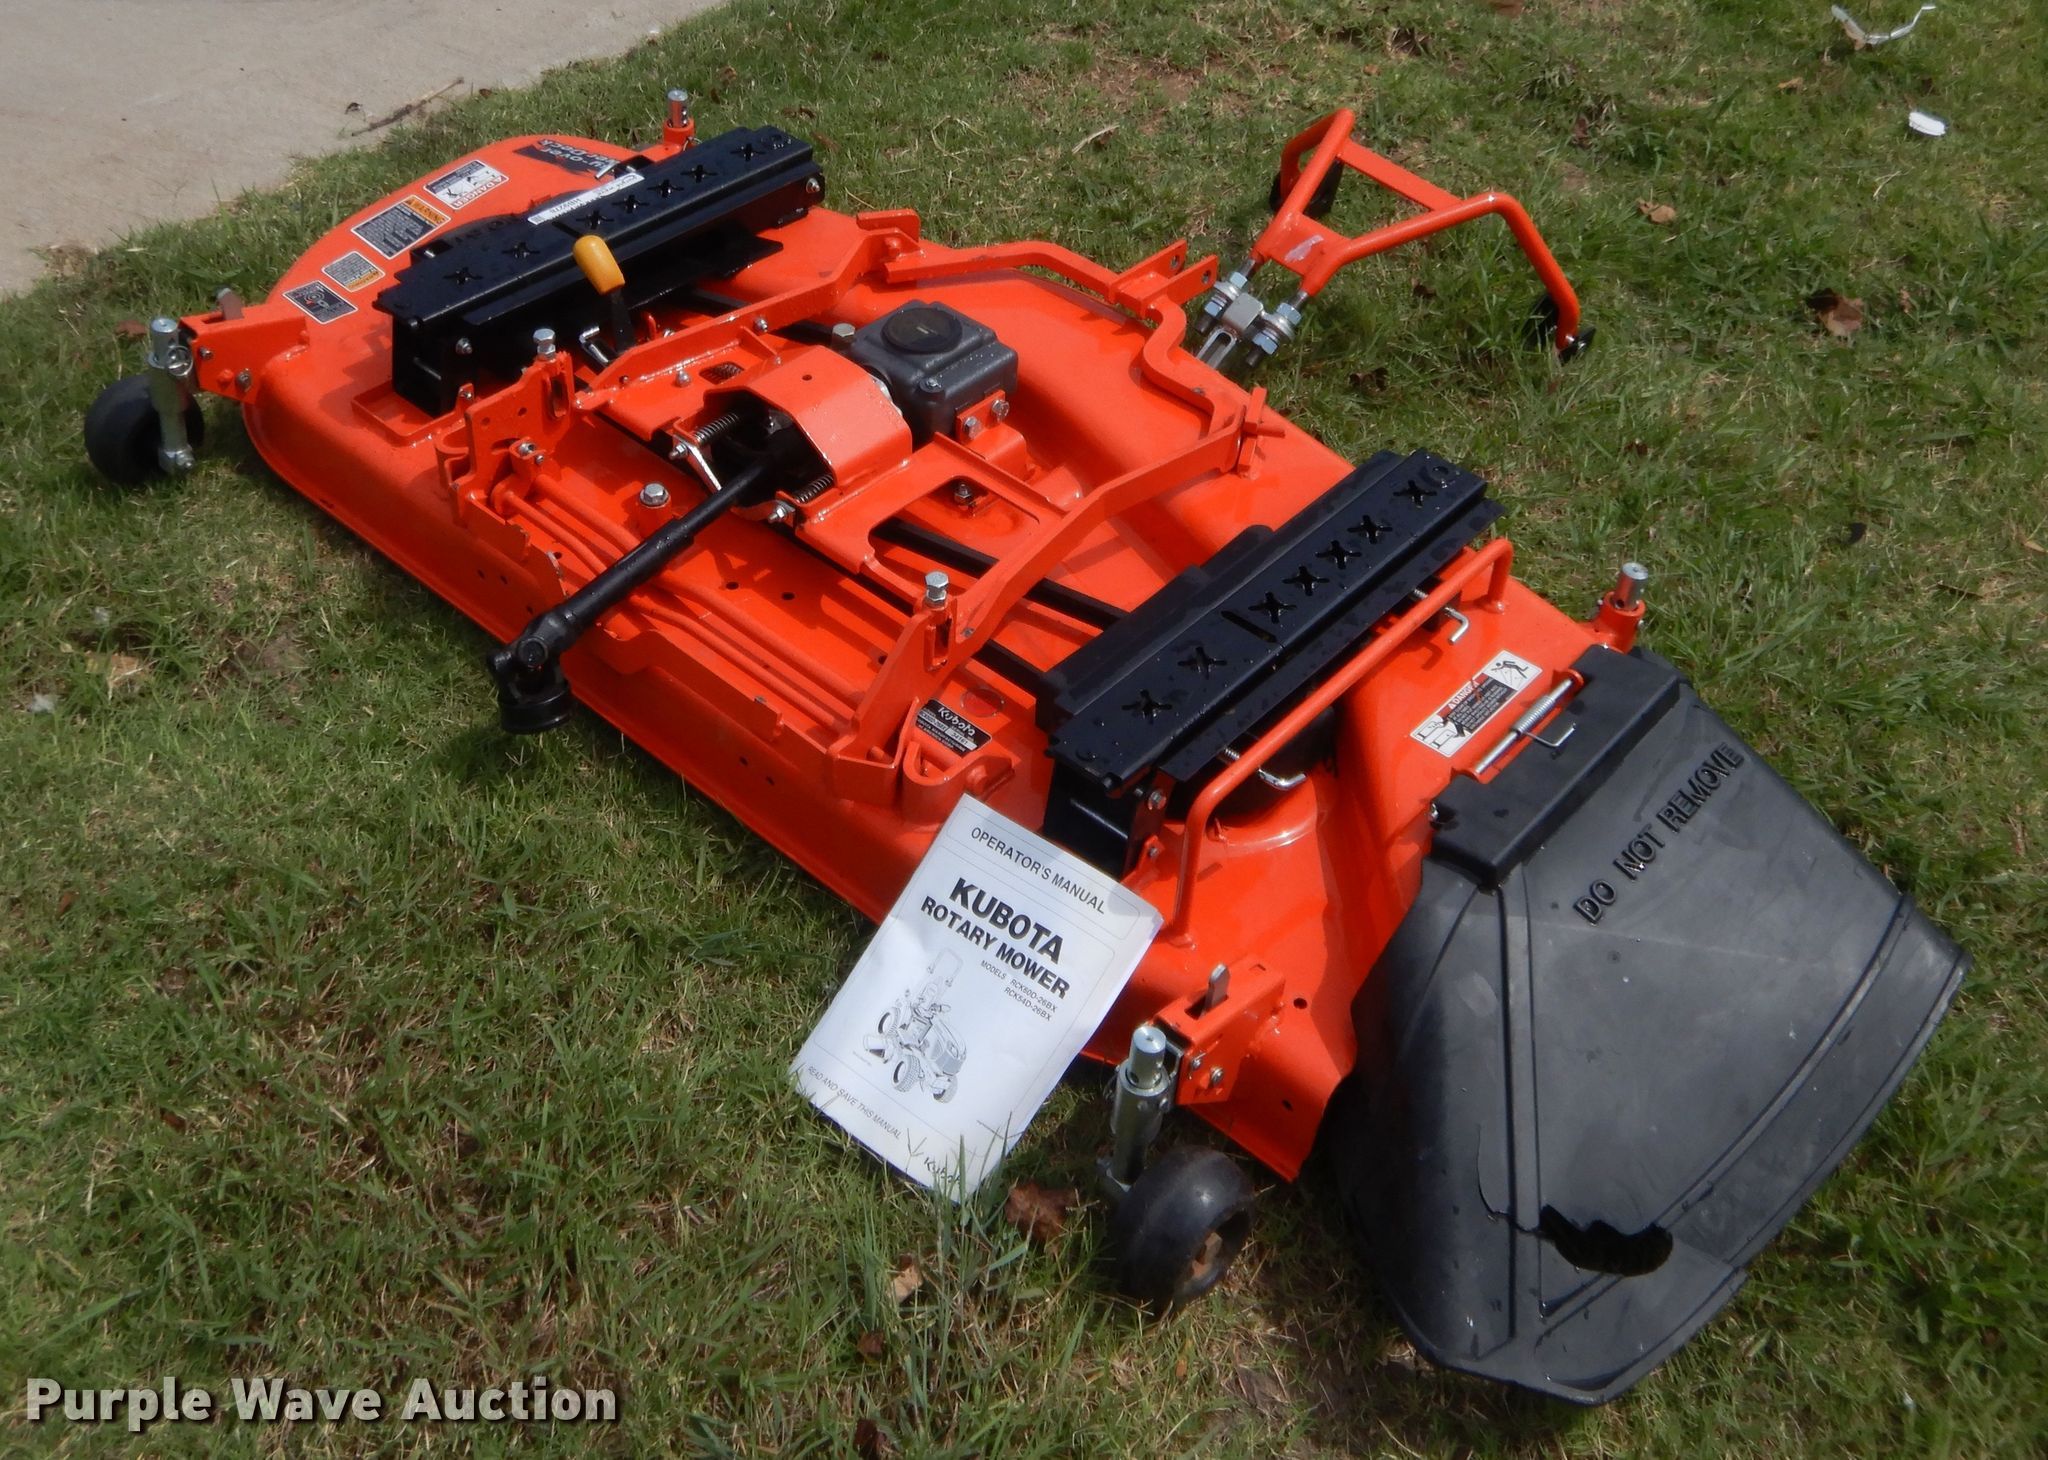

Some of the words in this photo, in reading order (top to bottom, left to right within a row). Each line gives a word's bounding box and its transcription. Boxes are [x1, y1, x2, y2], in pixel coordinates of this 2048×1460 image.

[938, 707, 976, 736] Kubota
[971, 827, 1052, 880] OPERATOR'S
[1051, 873, 1105, 914] MANUAL
[1572, 879, 1617, 926] DO
[1613, 824, 1666, 880] NOT
[1656, 742, 1745, 833] REMOVE
[921, 896, 998, 951] ROTARY
[995, 942, 1070, 999] MOWER
[949, 877, 1064, 964] KUBOTA
[981, 960, 1006, 980] MODELS
[808, 1066, 824, 1081] READ
[822, 1077, 839, 1092] AND
[837, 1089, 856, 1106] SAVE
[857, 1103, 874, 1118] THIS
[873, 1115, 902, 1139] MANUAL
